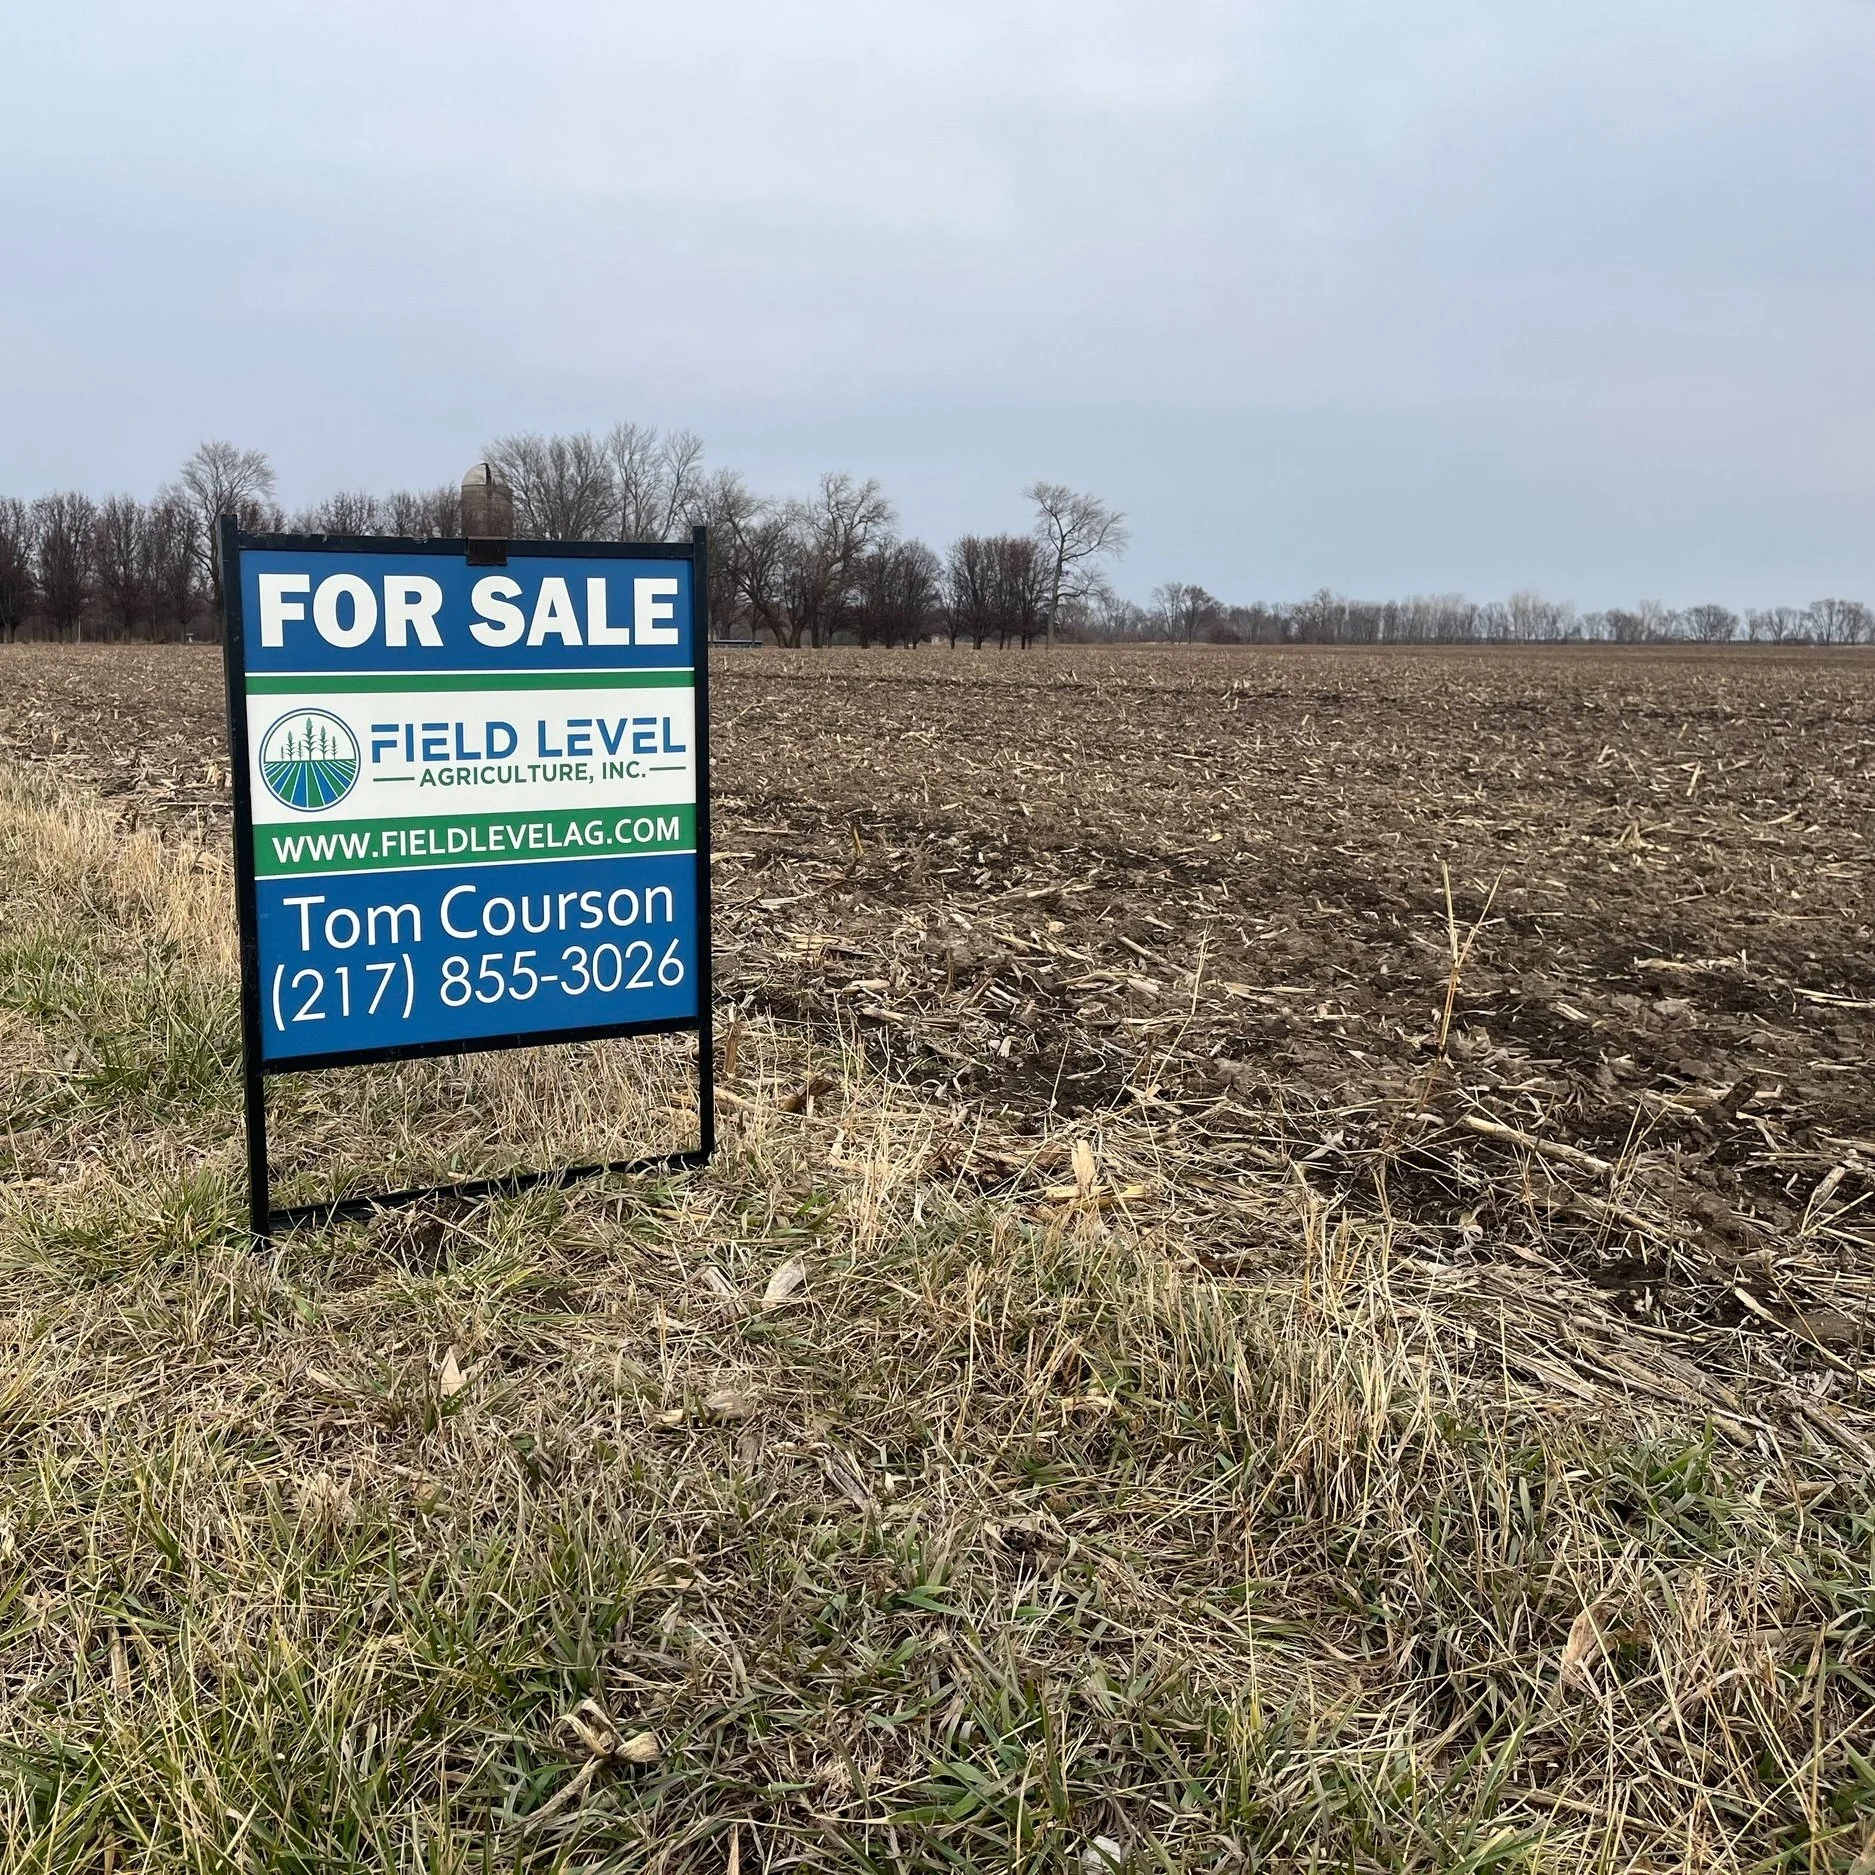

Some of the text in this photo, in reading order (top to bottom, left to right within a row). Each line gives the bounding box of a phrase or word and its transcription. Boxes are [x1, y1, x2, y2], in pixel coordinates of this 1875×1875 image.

[259, 573, 679, 647] FOR SALE
[371, 717, 686, 763] FIELD LEVEL
[420, 761, 646, 787] AGRICULTURE, INC.
[272, 816, 680, 863] WWW.FIELDLEVELAG.COM
[283, 884, 673, 951] Tom Courson
[272, 938, 684, 1031] (217) 855-3026
